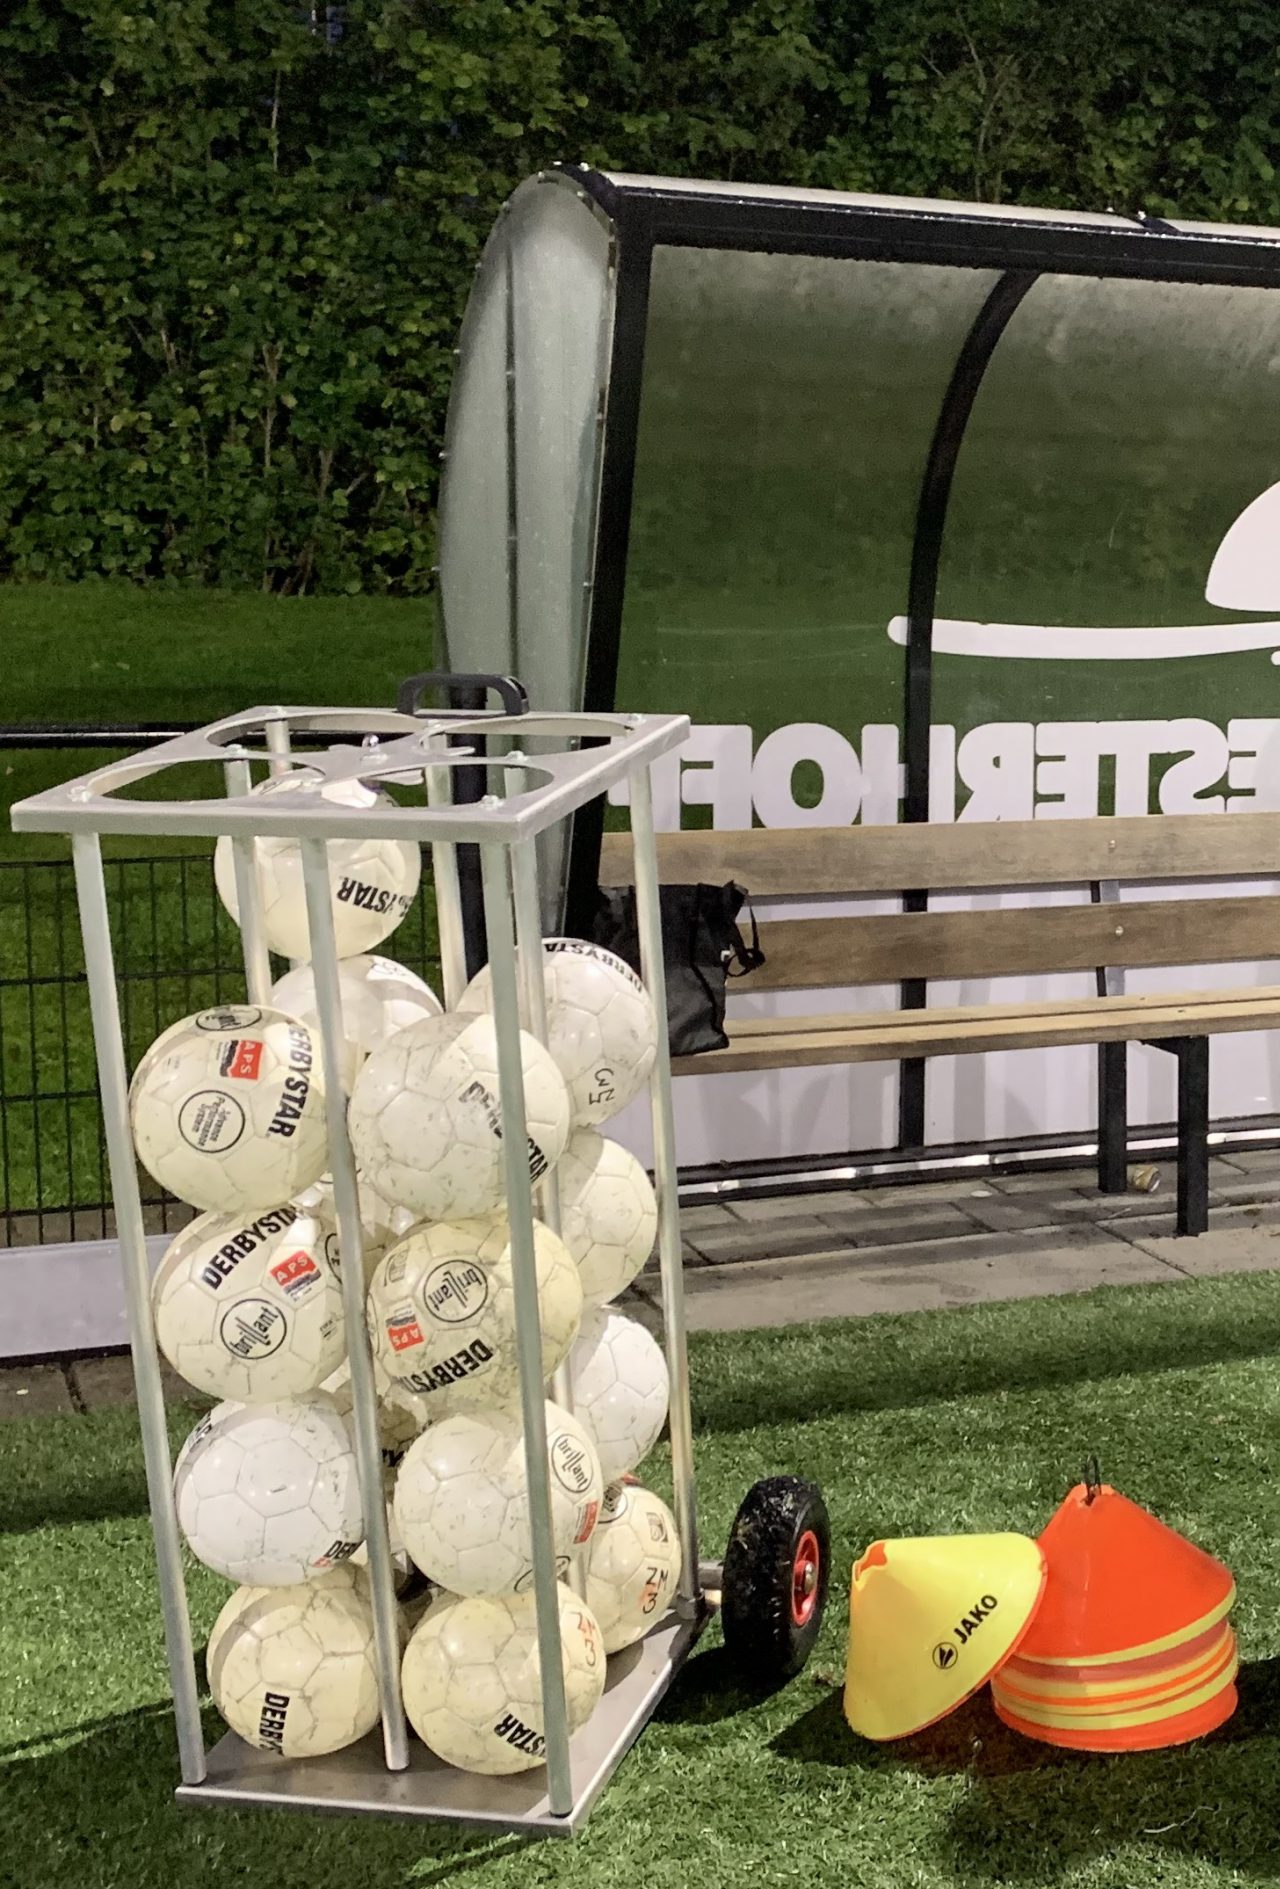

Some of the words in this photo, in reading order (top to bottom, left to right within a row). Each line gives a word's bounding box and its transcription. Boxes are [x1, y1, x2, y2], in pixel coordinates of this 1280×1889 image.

[275, 1255, 310, 1284] APS
[428, 1268, 483, 1312] brillant
[229, 1305, 280, 1356] brillant
[391, 1327, 420, 1345] APS
[556, 1438, 589, 1489] brillant
[953, 1595, 998, 1644] JAKO
